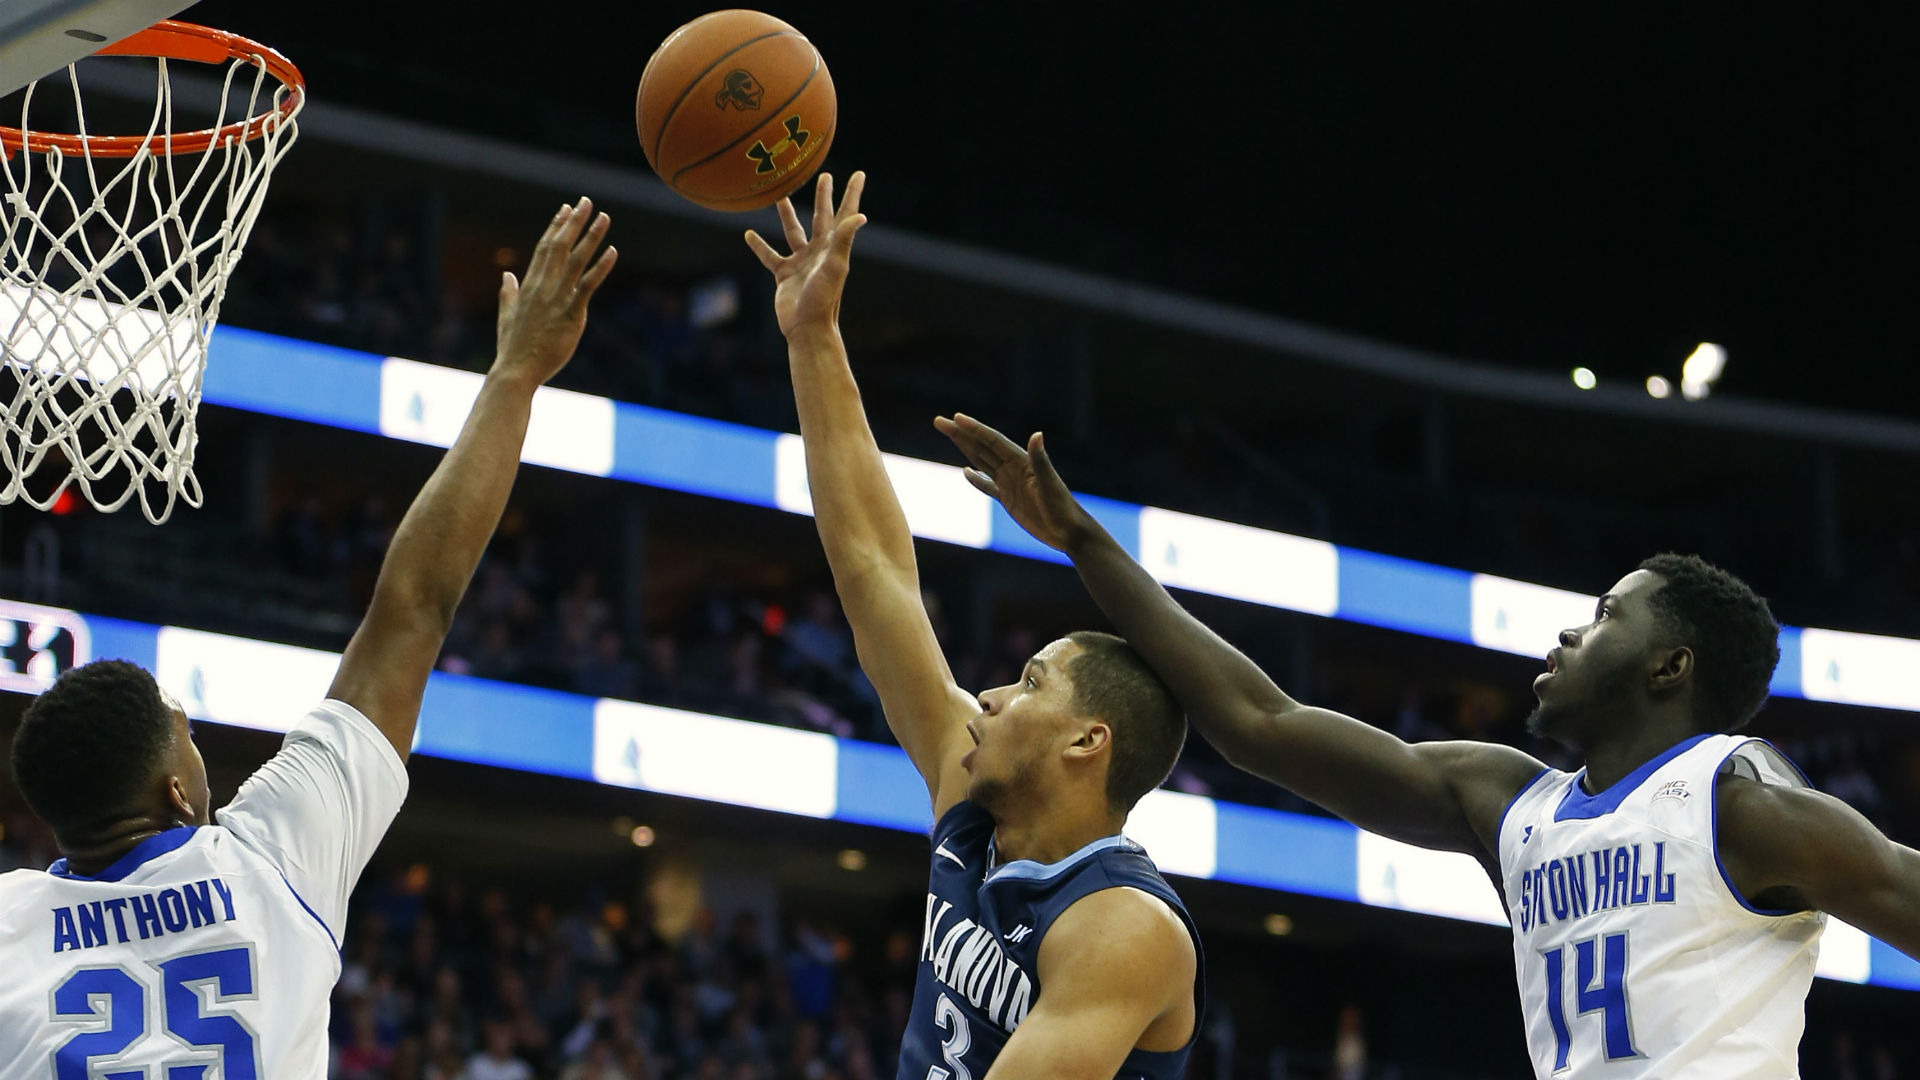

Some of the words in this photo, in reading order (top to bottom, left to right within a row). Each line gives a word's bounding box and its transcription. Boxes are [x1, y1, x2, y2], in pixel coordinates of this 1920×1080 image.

[51, 877, 237, 953] ANTHONY
[1587, 840, 1678, 915] HALL
[1003, 923, 1034, 943] JK
[49, 941, 264, 1080] 25
[925, 992, 972, 1080] 3
[1536, 929, 1651, 1077] 14
